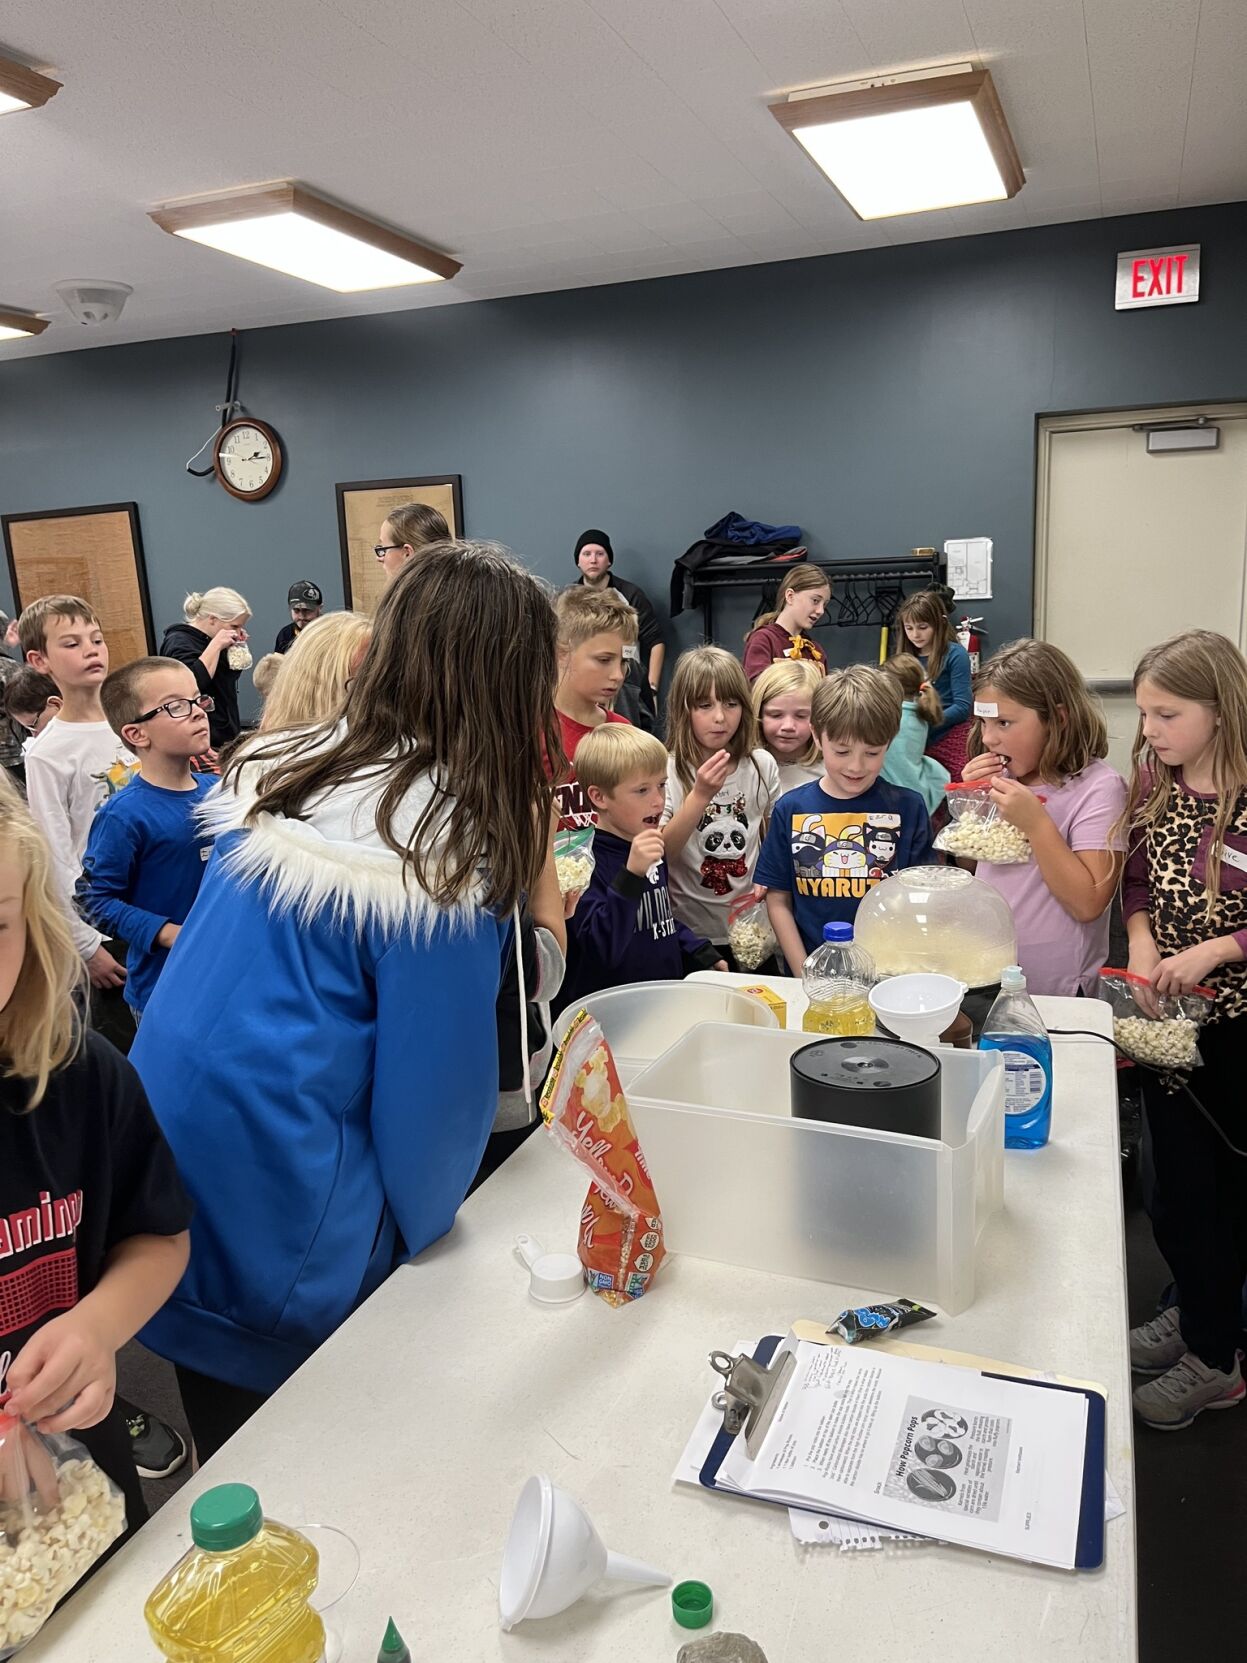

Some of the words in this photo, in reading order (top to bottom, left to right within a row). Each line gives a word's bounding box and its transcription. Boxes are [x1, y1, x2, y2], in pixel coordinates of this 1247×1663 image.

[1132, 255, 1188, 298] EXIT
[234, 436, 240, 444] 11
[242, 431, 250, 440] 12
[227, 445, 235, 454] 10
[907, 1416, 919, 1432] Pops
[900, 1433, 914, 1460] Popcorn
[896, 1460, 906, 1477] How
